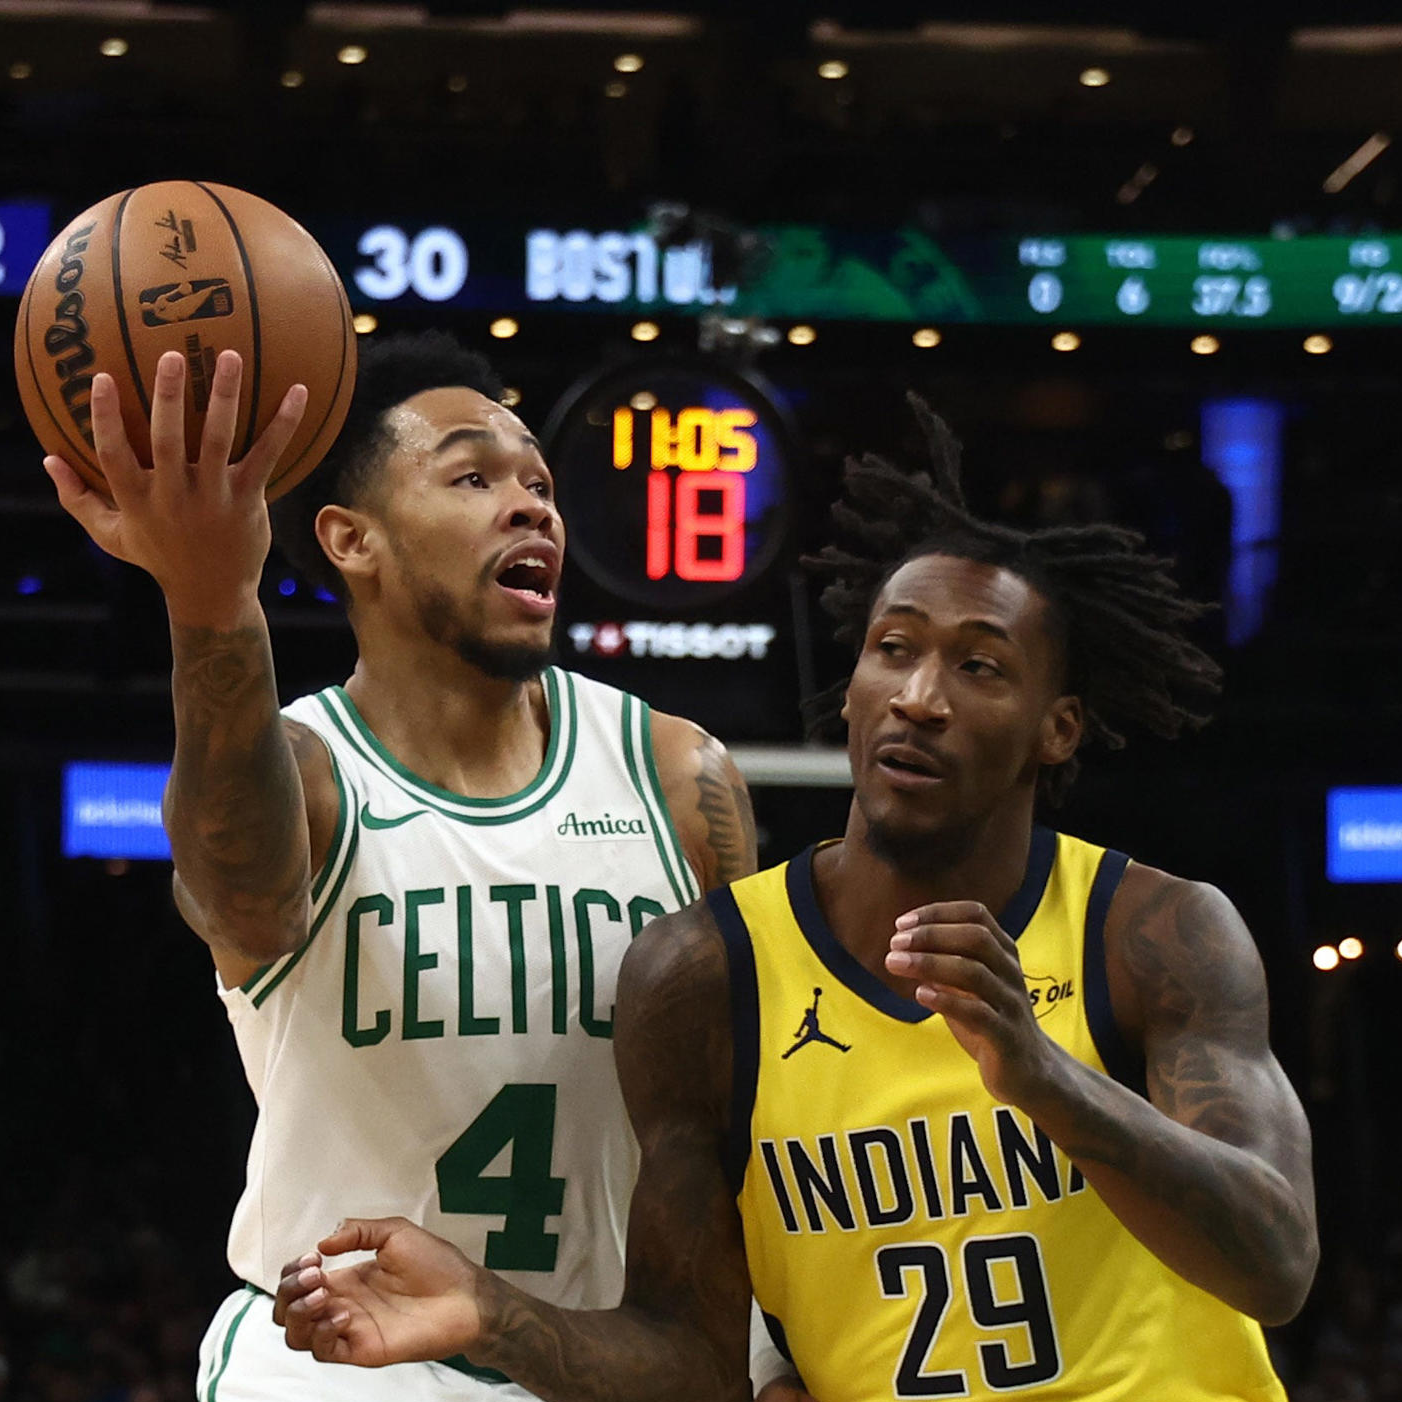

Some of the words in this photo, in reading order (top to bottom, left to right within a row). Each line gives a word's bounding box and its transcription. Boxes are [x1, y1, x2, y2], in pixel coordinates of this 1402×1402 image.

[354, 224, 469, 302] 30
[612, 406, 758, 473] 11:05
[646, 470, 747, 582] 18
[622, 621, 776, 659] TISSOT
[557, 812, 646, 837] Amica
[341, 884, 667, 1048] CELTIC
[1045, 979, 1075, 1003] OIL
[435, 1083, 567, 1273] 4
[874, 1231, 1064, 1400] 29
